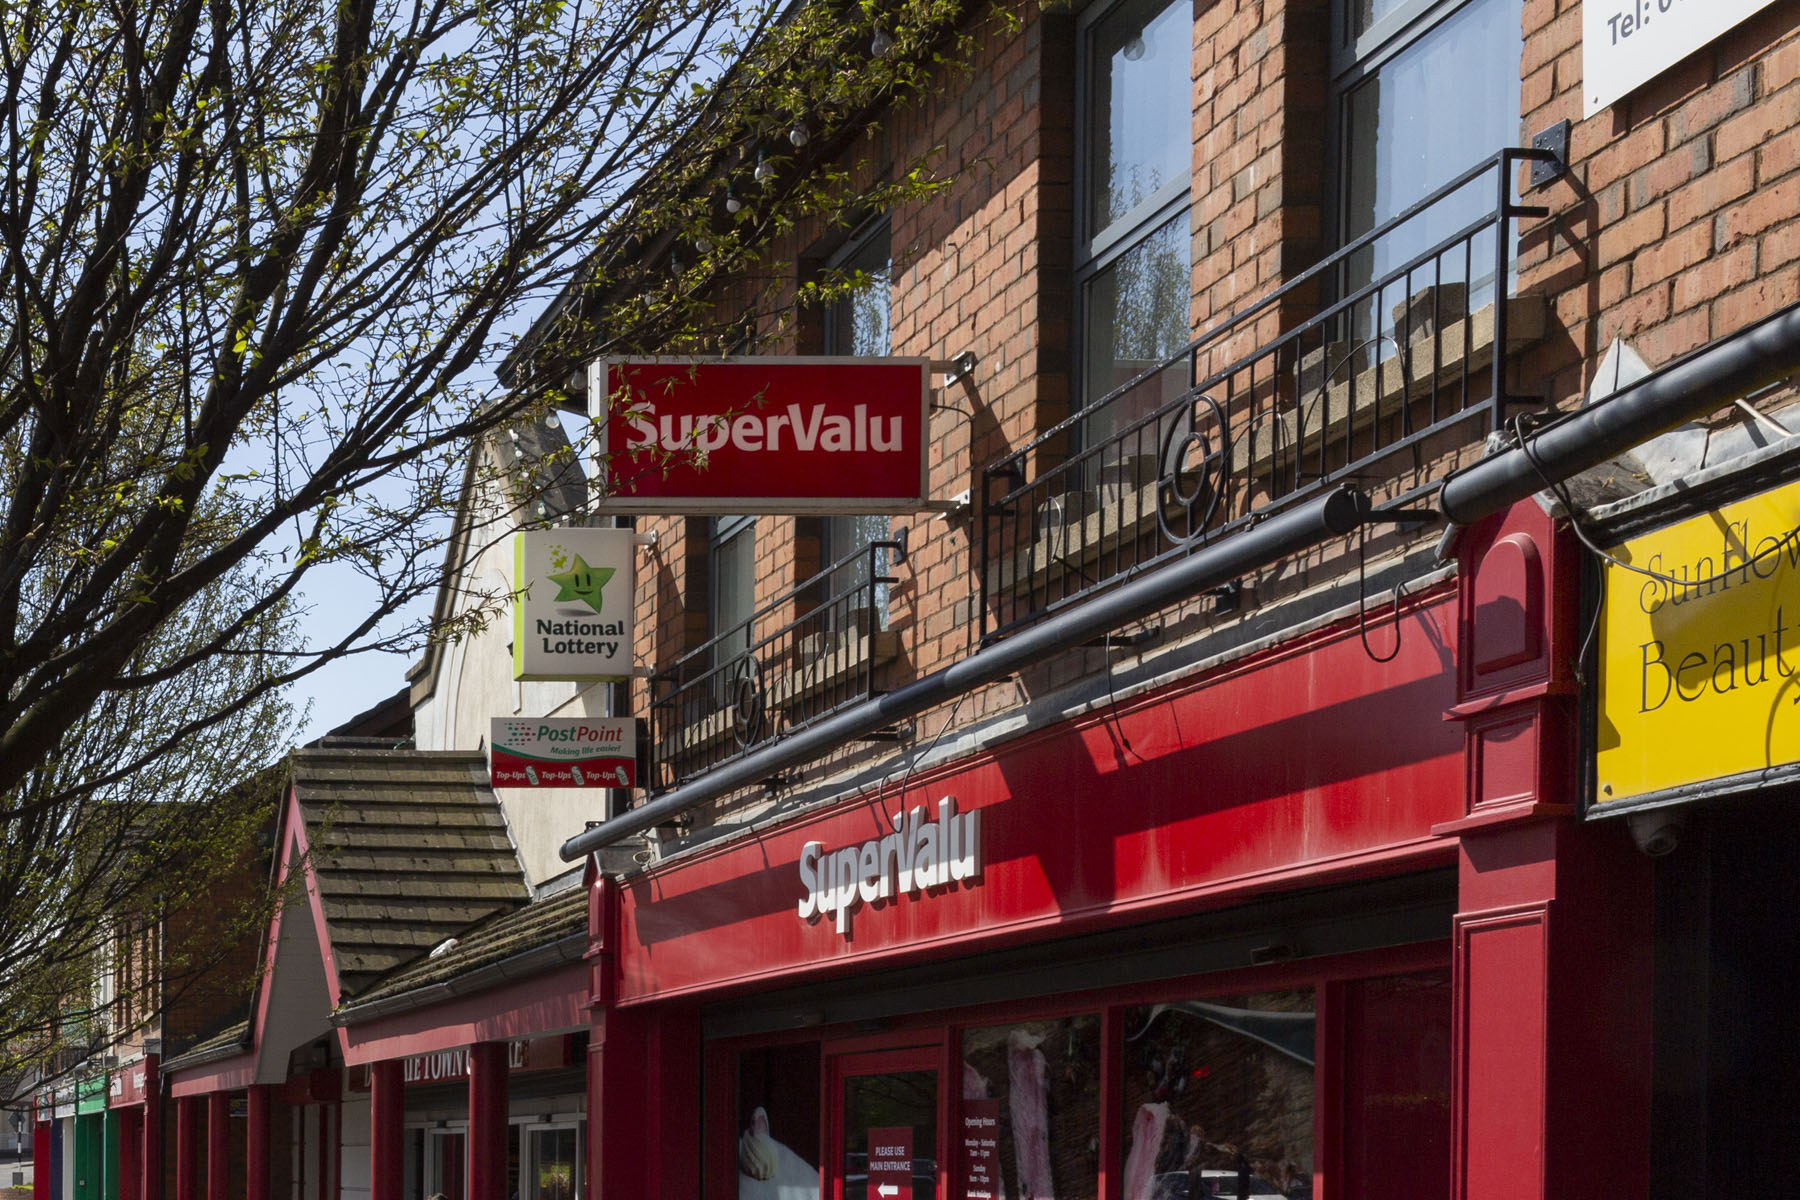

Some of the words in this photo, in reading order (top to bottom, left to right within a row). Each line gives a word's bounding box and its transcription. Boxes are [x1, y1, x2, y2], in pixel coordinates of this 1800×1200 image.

[1607, 0, 1650, 46] Tel:
[626, 402, 903, 468] SuperValu
[536, 619, 624, 636] National
[543, 638, 619, 659] Lottery
[1639, 605, 1800, 713] Beaut
[537, 725, 623, 742] PostPoint
[550, 746, 580, 757] Making
[582, 746, 594, 754] life
[496, 770, 526, 781] Top-Ups
[541, 770, 571, 781] Top-Ups
[586, 770, 616, 781] Top-Ups
[798, 795, 981, 934] SuperValu
[965, 1117, 982, 1128] Opening
[983, 1117, 996, 1126] Hours
[875, 1146, 894, 1156] PLEASE
[895, 1146, 905, 1156] USE
[870, 1161, 884, 1171] MAIN
[884, 1161, 911, 1171] ENTRANCE
